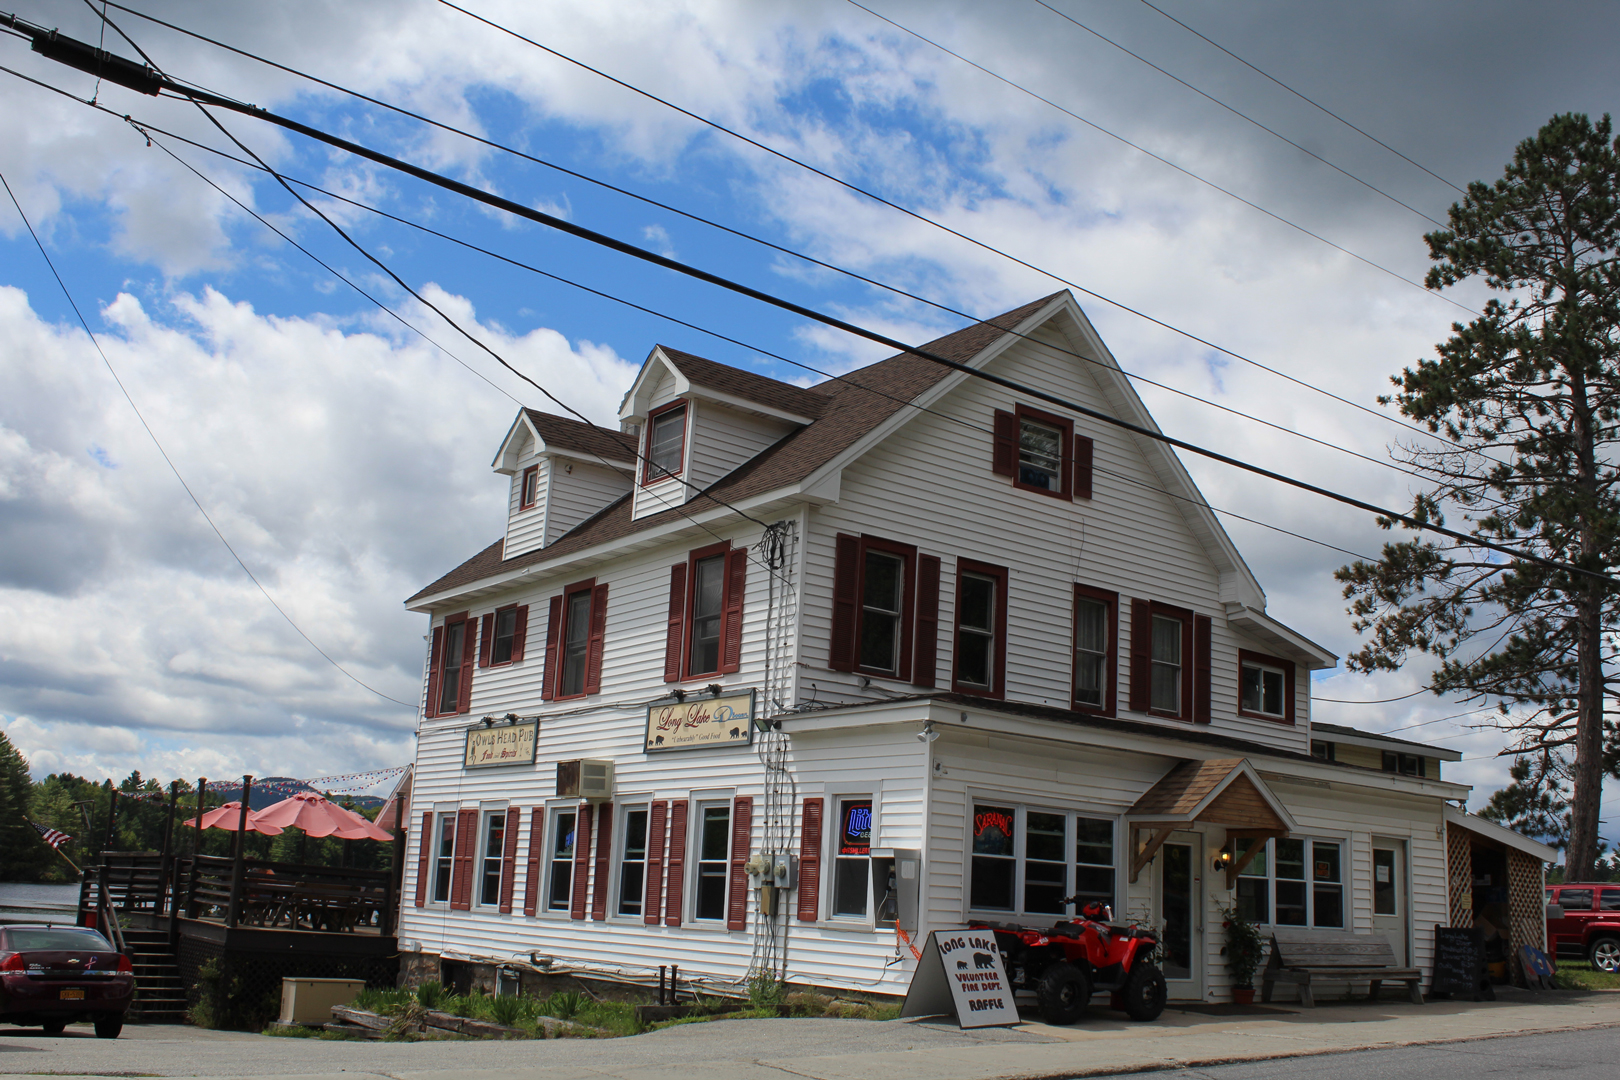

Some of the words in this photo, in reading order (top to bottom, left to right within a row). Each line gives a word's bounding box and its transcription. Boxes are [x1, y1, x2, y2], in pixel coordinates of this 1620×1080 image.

[656, 707, 682, 734] Long
[684, 703, 710, 728] Lake
[475, 733, 496, 747] OWLS
[496, 730, 517, 744] HEAD
[518, 728, 534, 742] PUB
[974, 812, 1013, 837] SARANAC
[939, 937, 966, 955] LONG
[968, 937, 997, 954] LAKE
[955, 972, 999, 983] VOLUNTEER
[962, 983, 979, 993] FIRE
[981, 982, 1003, 992] DEPT.
[968, 998, 1005, 1012] RAFFLE
